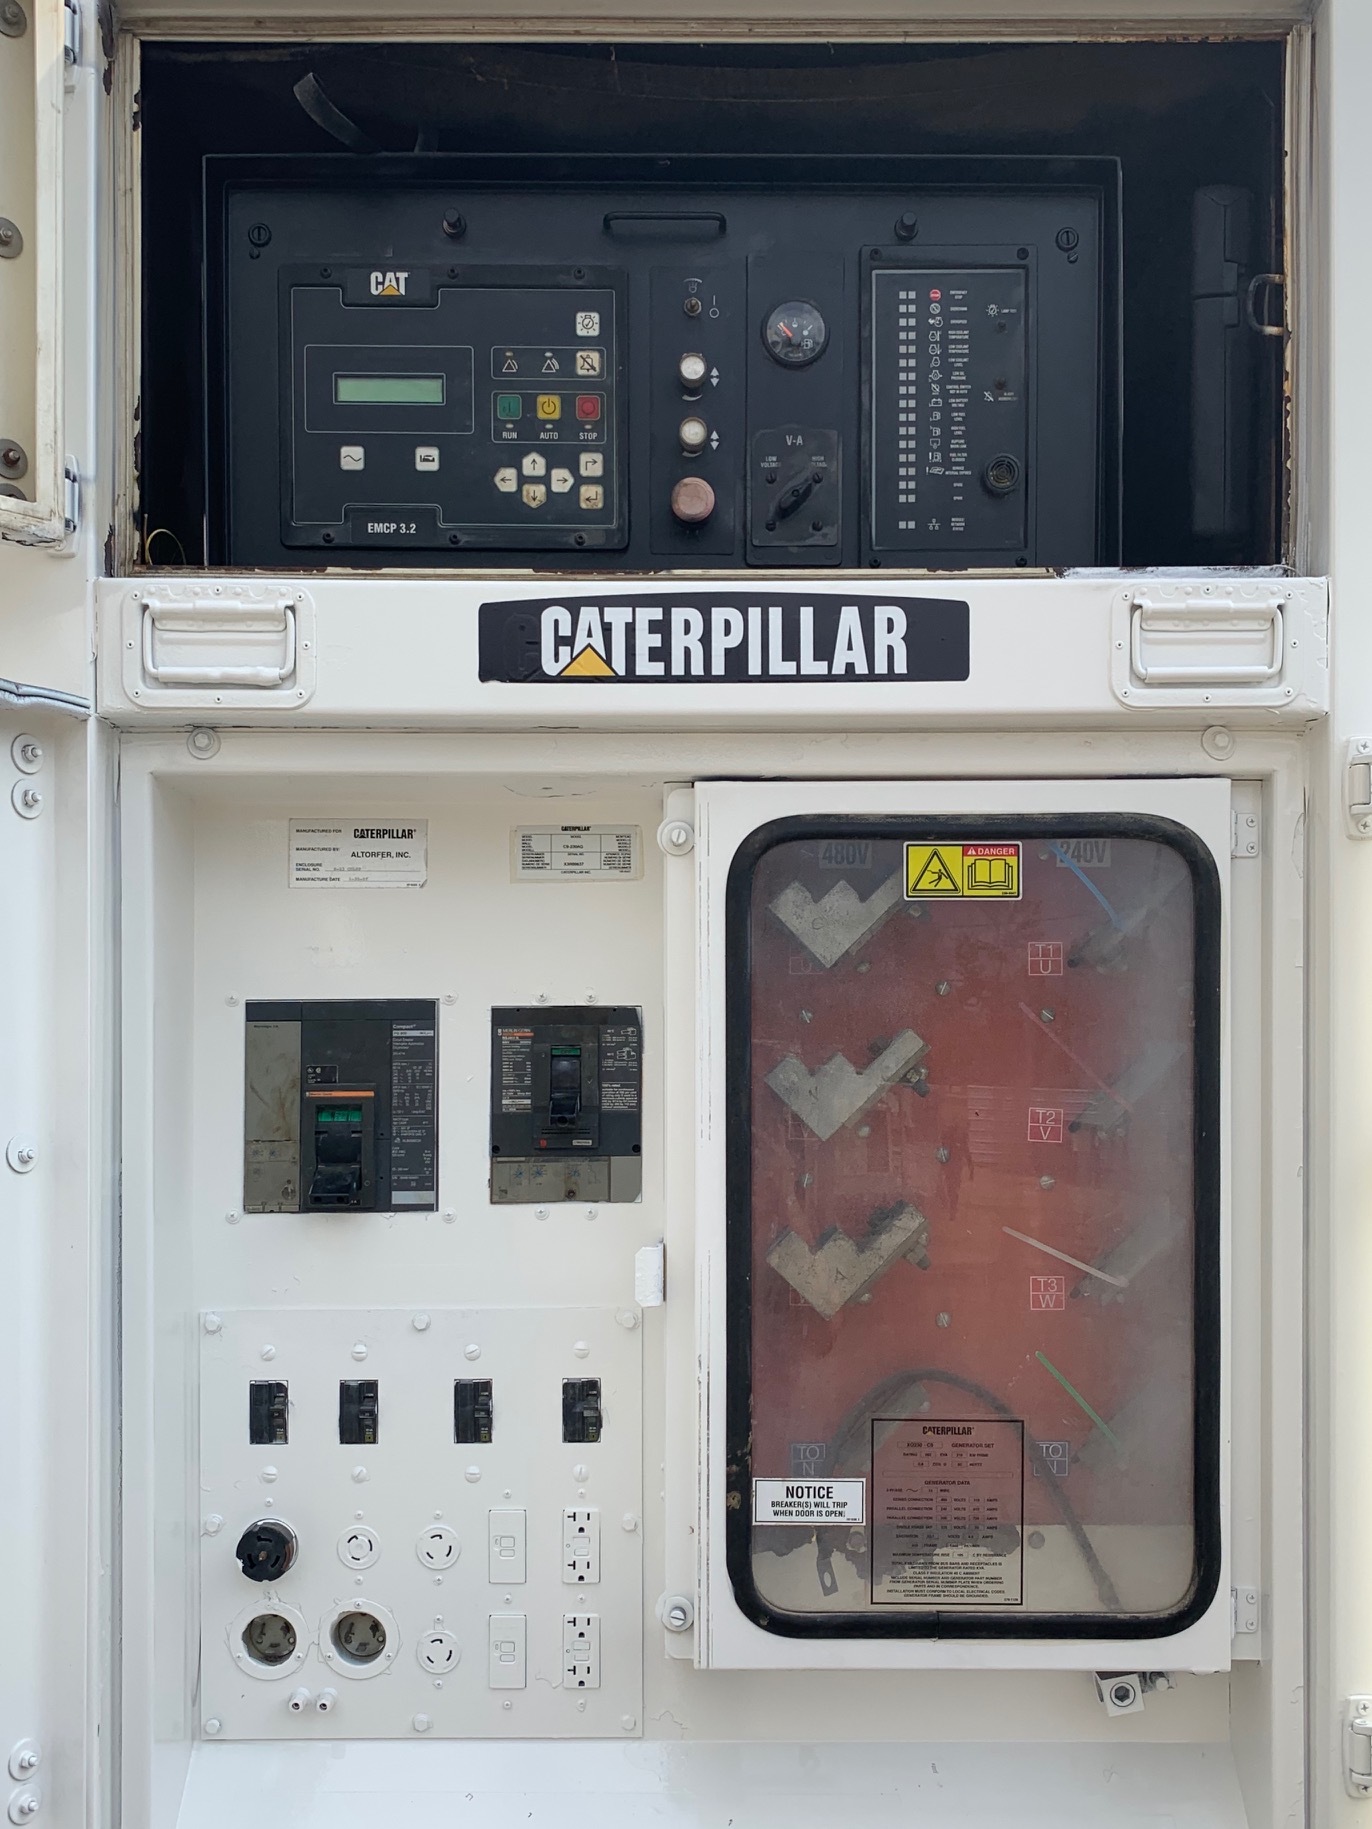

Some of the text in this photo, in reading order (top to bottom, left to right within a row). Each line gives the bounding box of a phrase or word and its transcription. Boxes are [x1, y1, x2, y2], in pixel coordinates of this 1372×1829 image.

[370, 272, 408, 296] CAT
[502, 432, 598, 440] RUN AUTO STOP
[786, 435, 804, 446] V-A
[368, 523, 416, 534] EMCP 3.2
[540, 604, 908, 677] CATERPILLAR
[353, 828, 414, 839] CATERPILLAR
[351, 851, 411, 859] ALTORFER, INC.
[822, 842, 870, 866] 480V
[978, 847, 1015, 856] DANGER
[1058, 840, 1106, 865] 240V
[1035, 944, 1053, 958] T1
[1040, 960, 1052, 974] U
[1036, 1111, 1056, 1125] T2
[1040, 1126, 1051, 1140] V
[1037, 1278, 1058, 1292] T3
[1040, 1294, 1056, 1308] W
[922, 1426, 972, 1436] CATERPILLAR
[803, 1462, 814, 1476] N
[786, 1486, 834, 1499] NOTICE
[771, 1501, 812, 1510] BREAKER(S)
